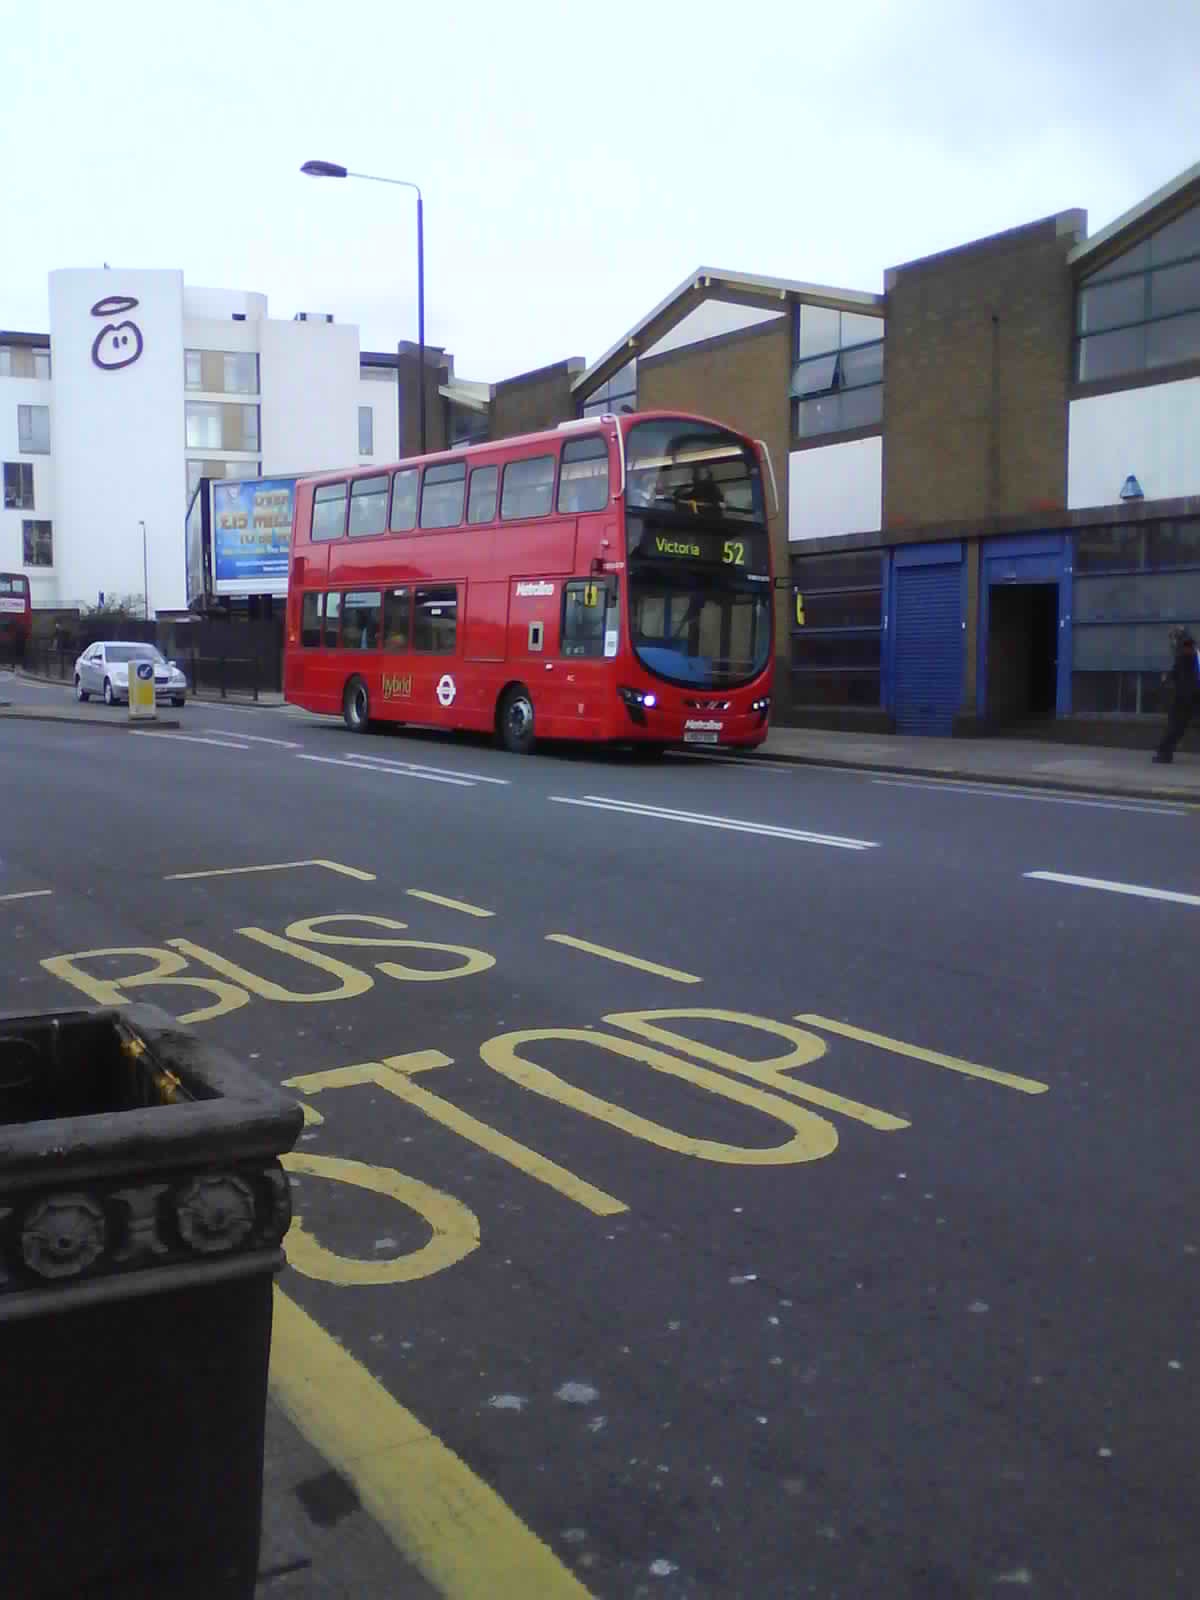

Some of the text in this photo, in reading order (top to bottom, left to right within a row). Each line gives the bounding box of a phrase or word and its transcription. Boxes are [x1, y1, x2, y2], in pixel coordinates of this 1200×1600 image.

[655, 537, 700, 556] Victoria
[722, 541, 745, 565] 52
[382, 672, 411, 699] hybrid
[39, 914, 497, 1024] BUS
